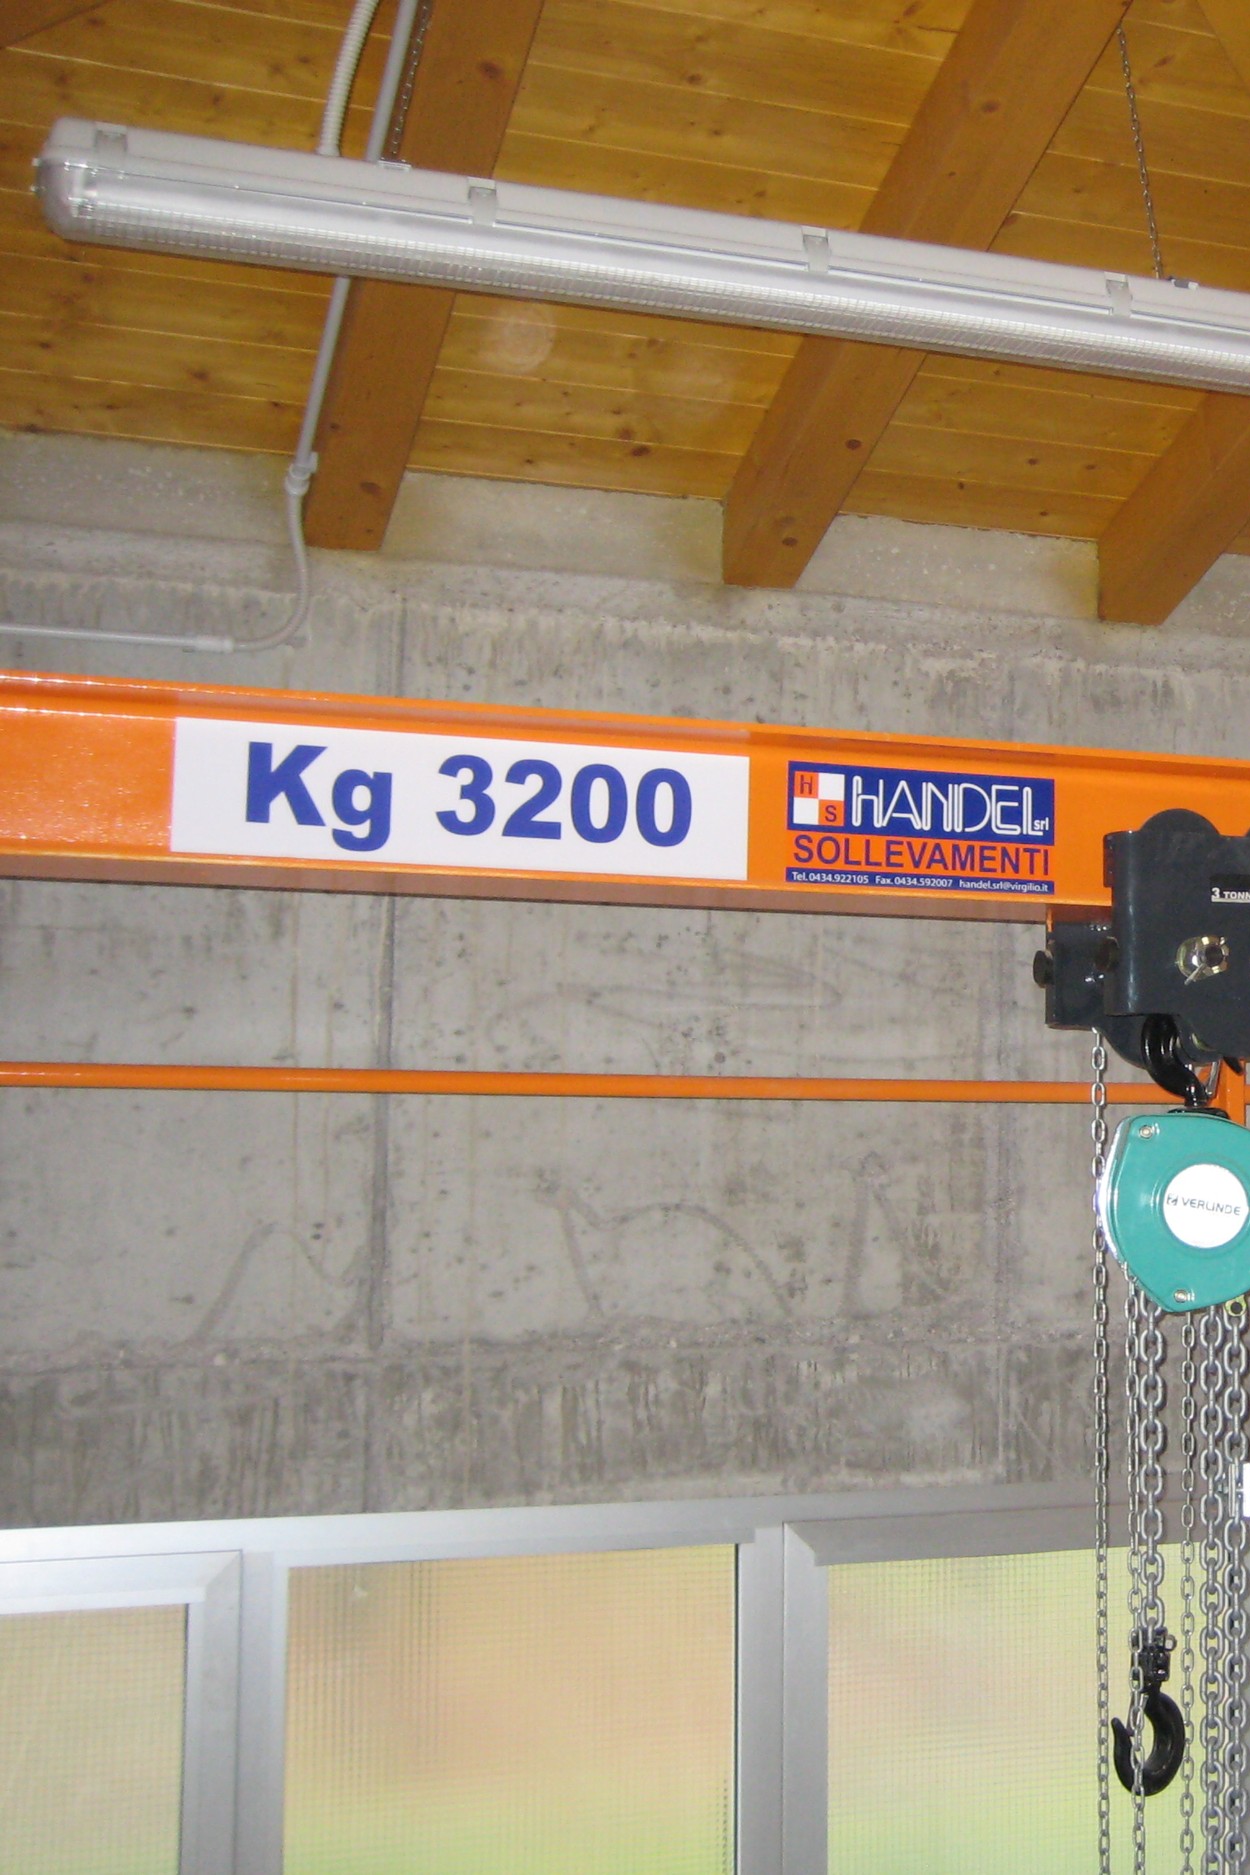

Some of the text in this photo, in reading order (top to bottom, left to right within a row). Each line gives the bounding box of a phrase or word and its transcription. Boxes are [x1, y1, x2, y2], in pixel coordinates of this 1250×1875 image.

[799, 775, 813, 795] H
[245, 741, 693, 852] Kg 3200
[852, 775, 1044, 836] HANDEL
[824, 804, 837, 823] S
[793, 834, 1050, 876] SOLLEVAMENTI
[959, 879, 1049, 893] handel.srl@virgilio.it
[1211, 887, 1221, 899] 3
[1181, 1196, 1242, 1216] VERLINDE
